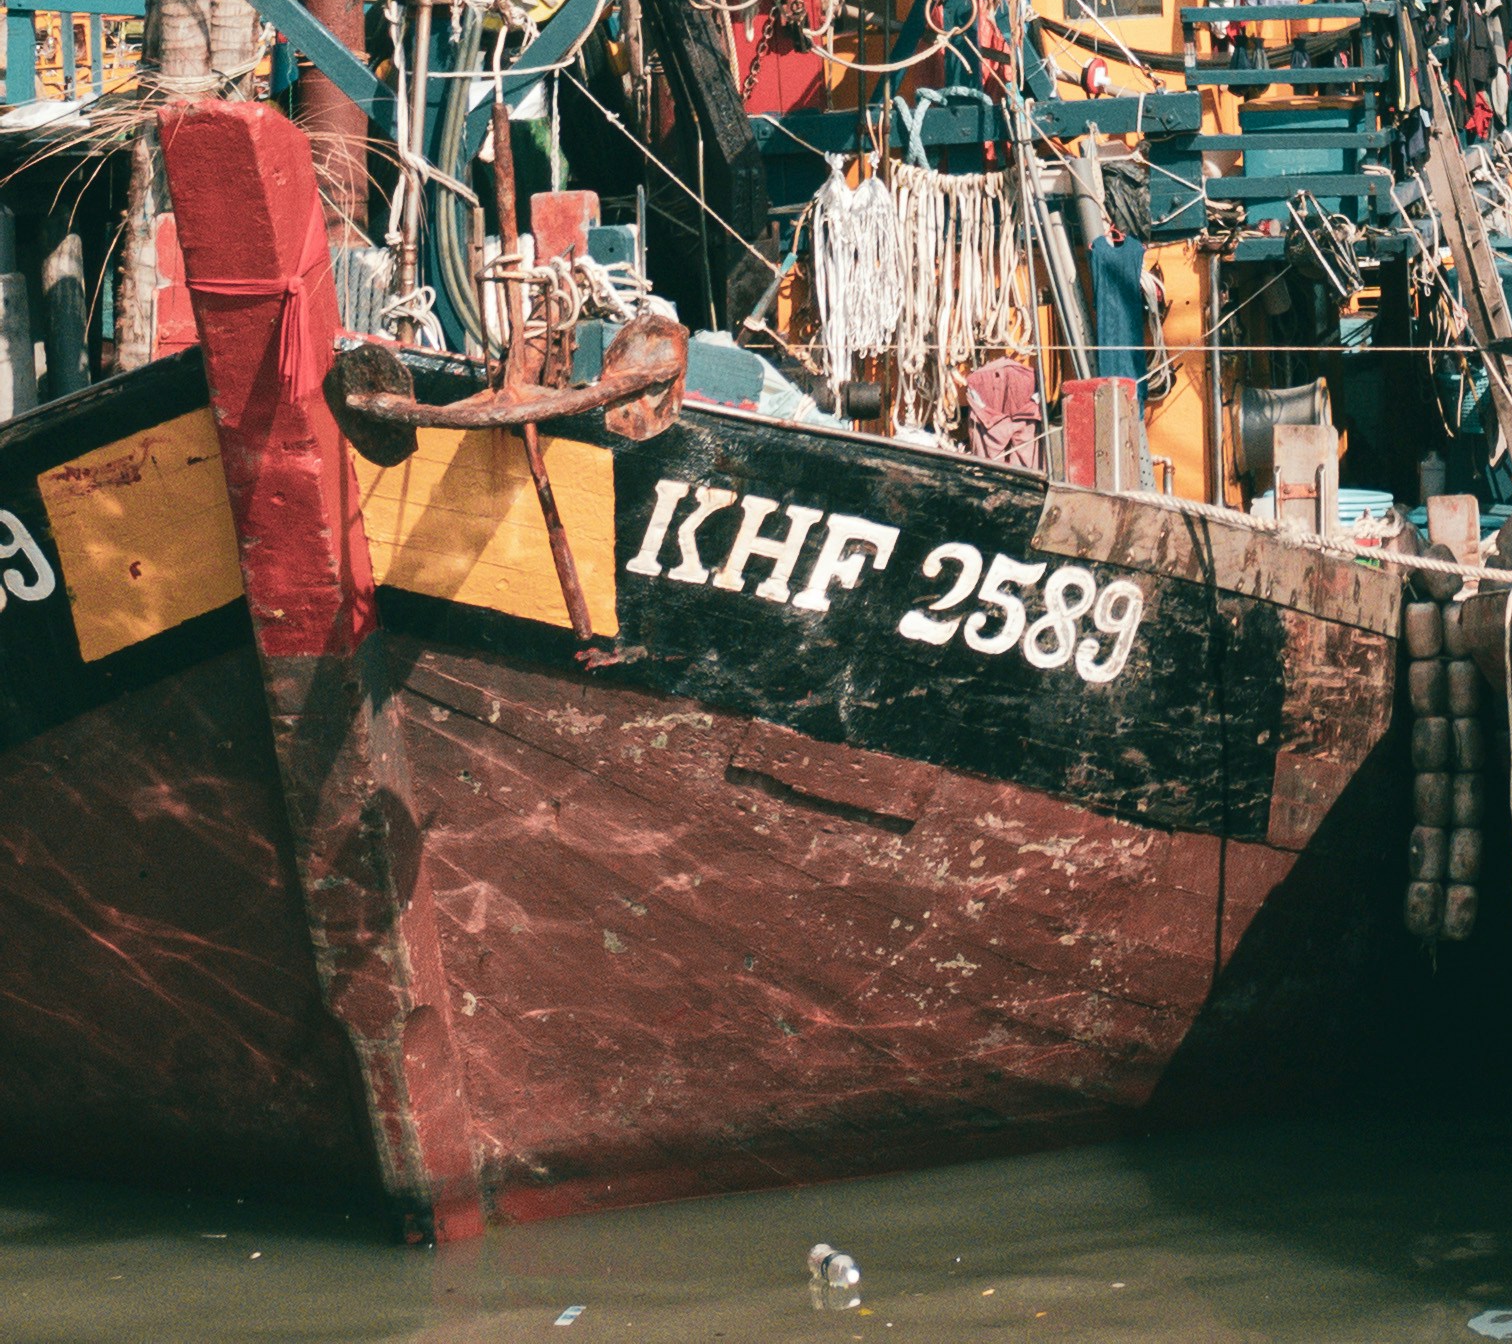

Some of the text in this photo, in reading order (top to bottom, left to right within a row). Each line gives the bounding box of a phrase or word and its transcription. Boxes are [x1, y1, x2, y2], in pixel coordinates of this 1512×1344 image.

[0, 509, 55, 613] 9
[626, 479, 1144, 683] KHF 2589
